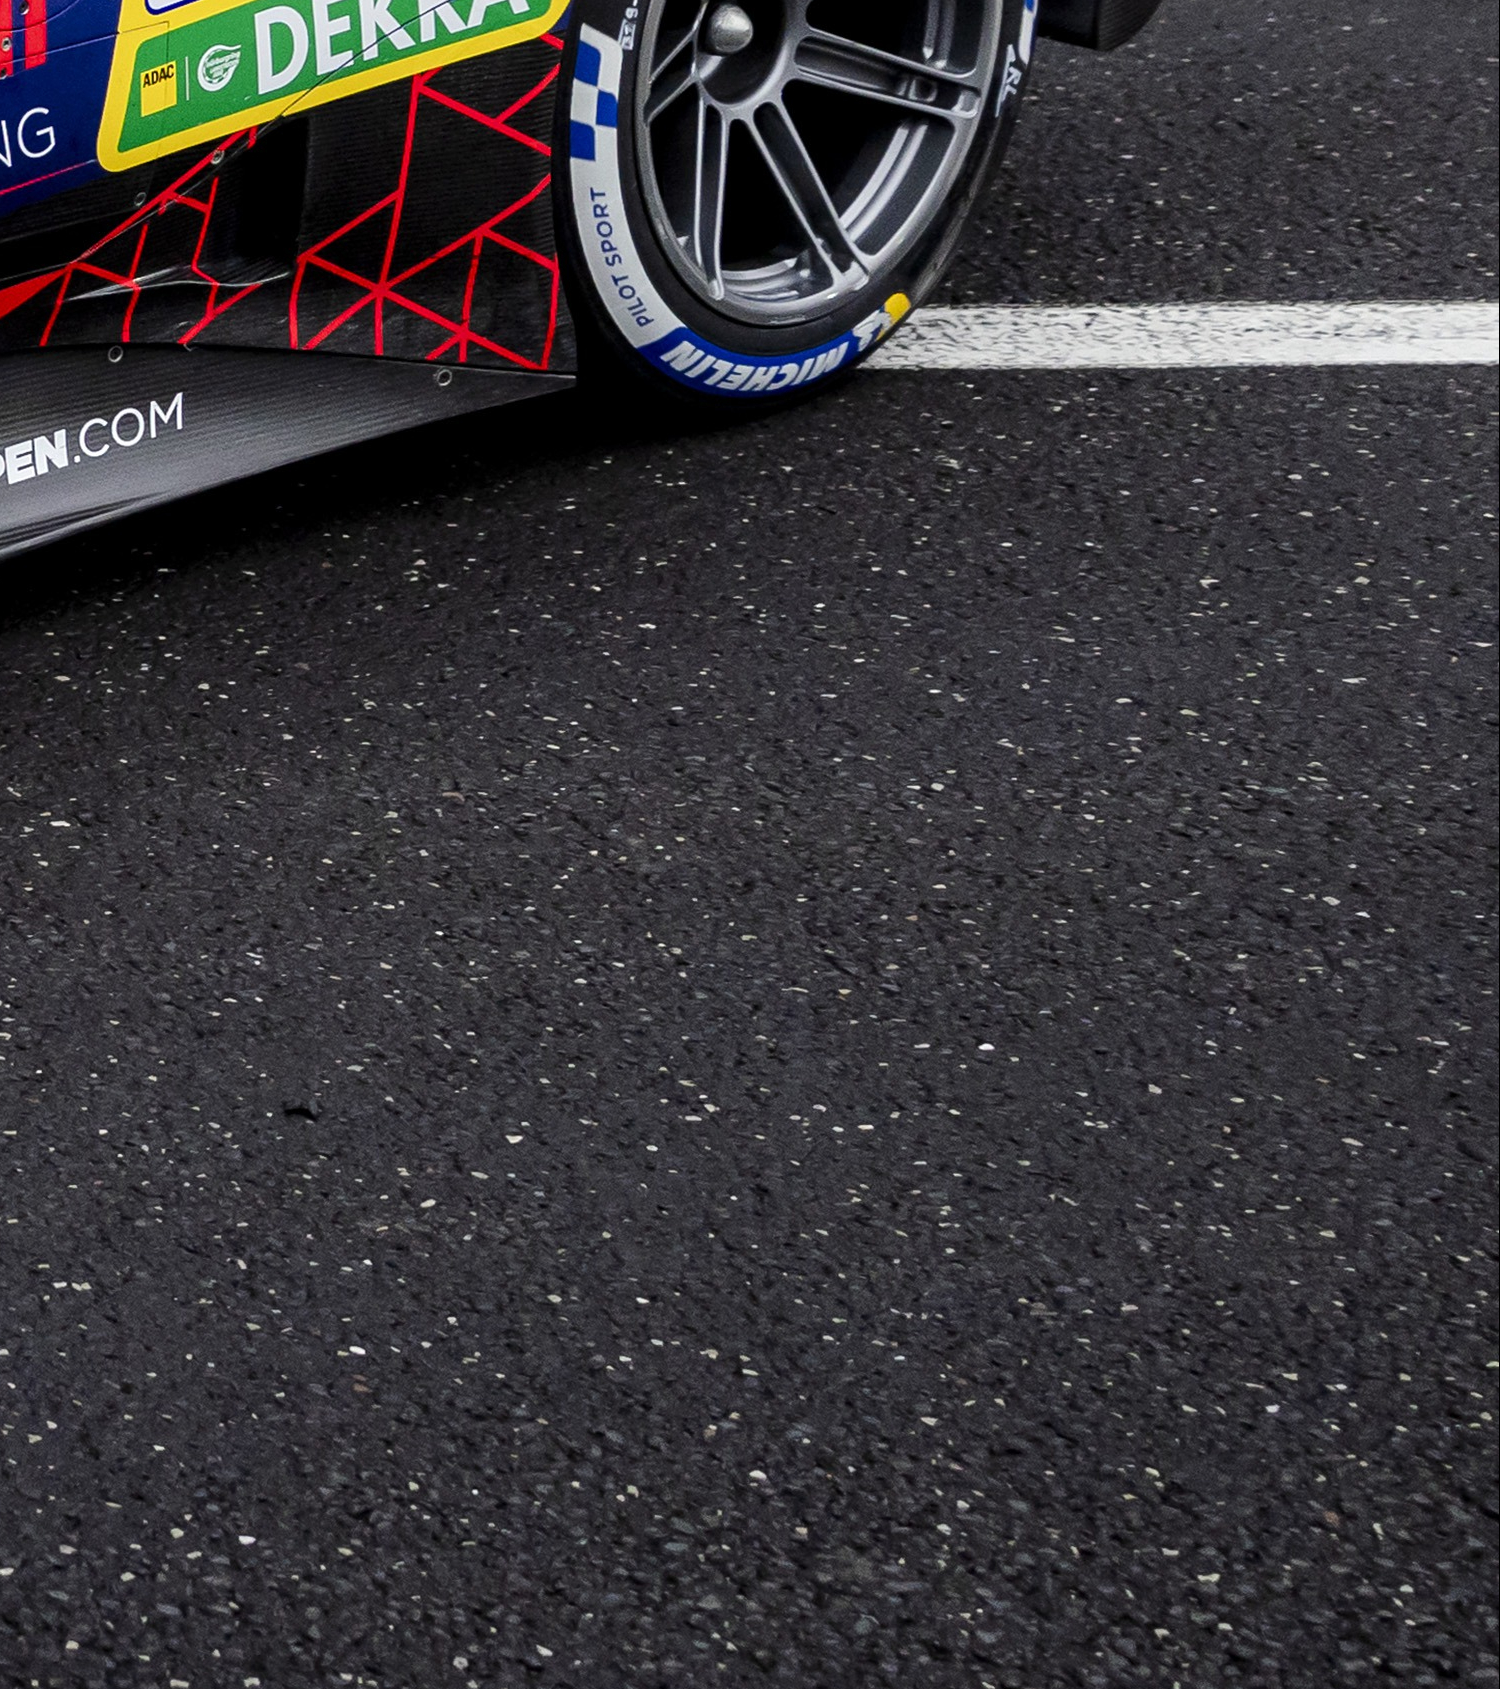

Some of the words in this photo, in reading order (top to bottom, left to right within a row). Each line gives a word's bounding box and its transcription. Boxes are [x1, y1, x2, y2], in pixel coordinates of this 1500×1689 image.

[141, 63, 176, 89] ADAC
[589, 186, 623, 267] SPORT
[607, 265, 656, 329] PILOT
[657, 337, 853, 396] MICHELIN
